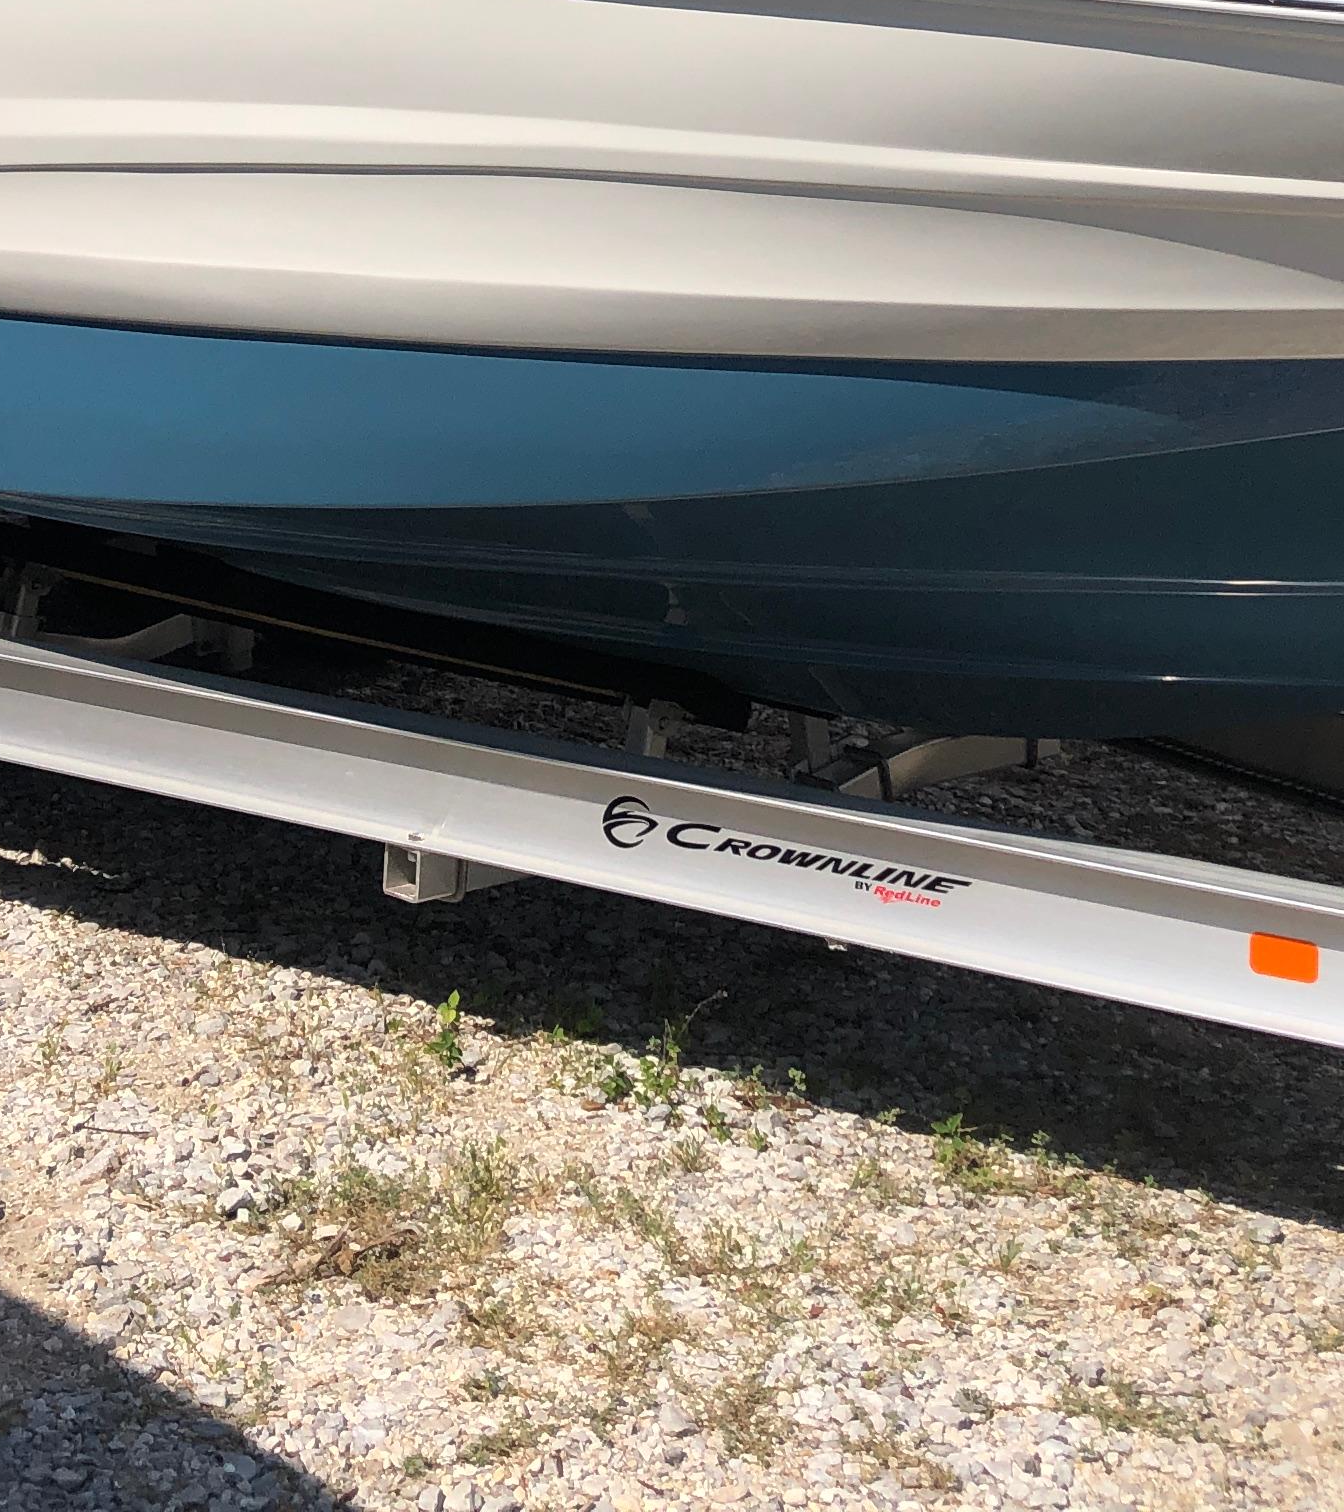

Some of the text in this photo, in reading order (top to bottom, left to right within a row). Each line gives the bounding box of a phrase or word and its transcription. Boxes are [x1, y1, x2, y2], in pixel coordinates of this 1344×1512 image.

[666, 823, 973, 894] CROWNLINE
[855, 880, 942, 908] BY RedLine
